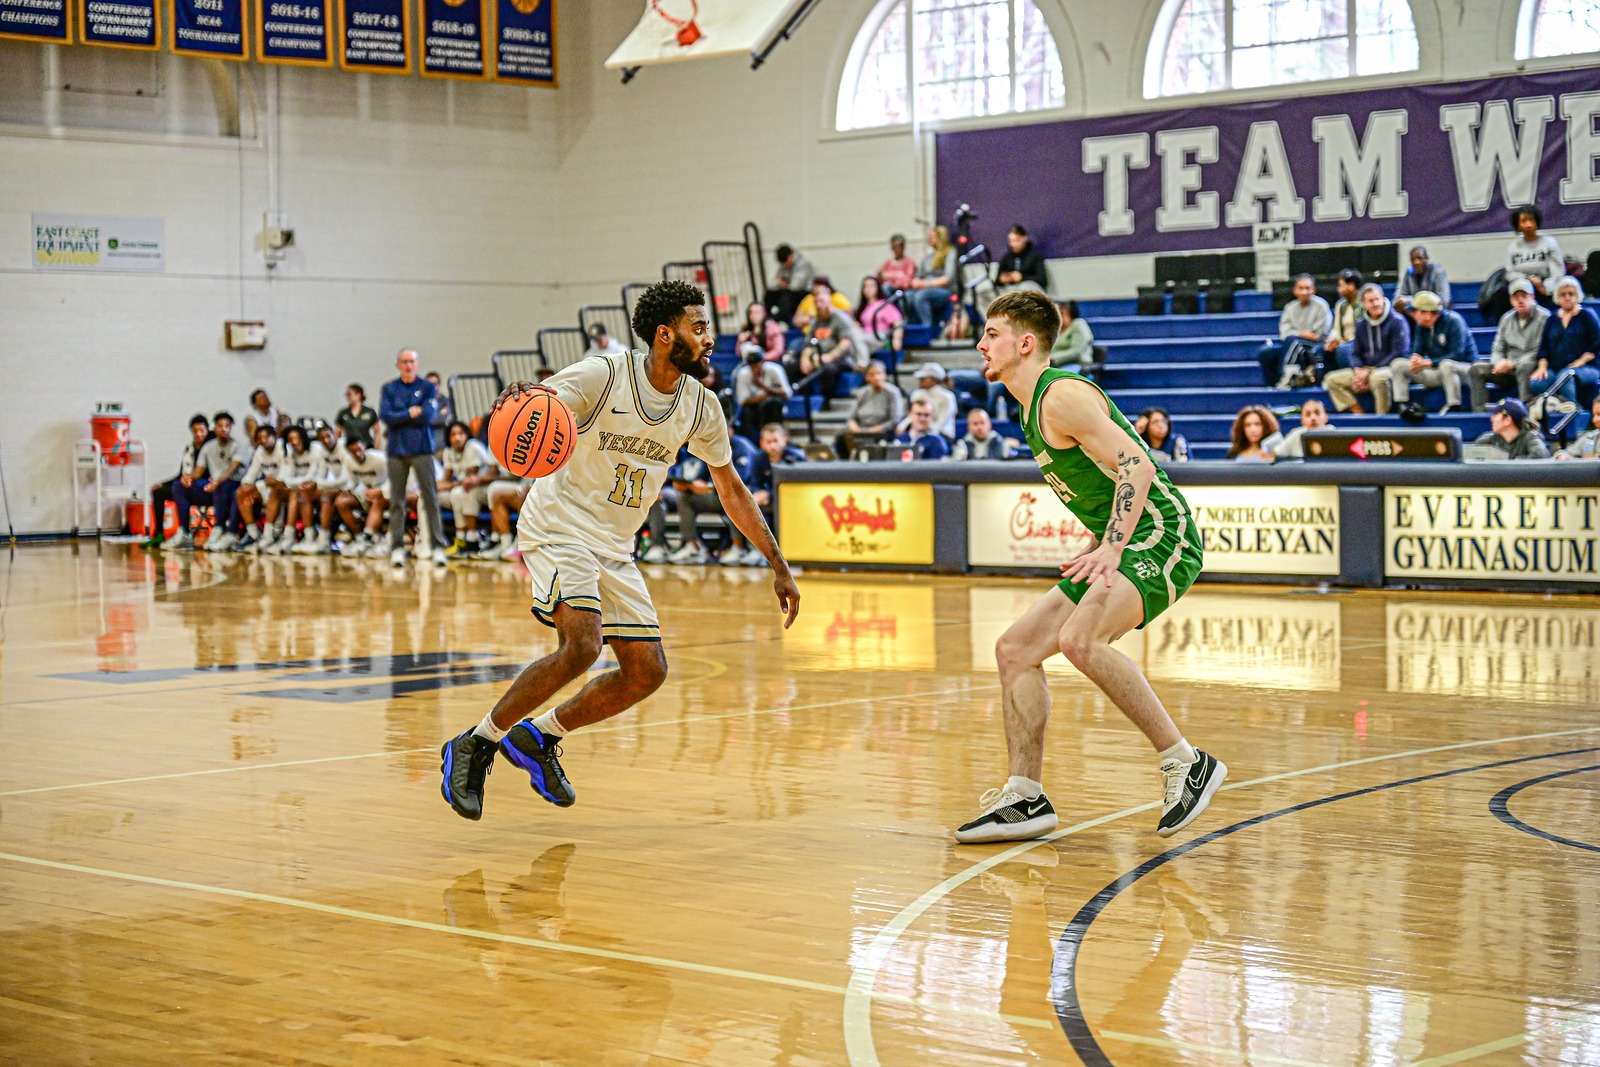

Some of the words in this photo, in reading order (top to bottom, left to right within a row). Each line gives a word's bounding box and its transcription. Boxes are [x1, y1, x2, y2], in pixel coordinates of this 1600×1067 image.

[88, 1, 152, 17] CONFERENCE
[194, 0, 224, 11] 2011
[270, 3, 320, 20] 2015-16
[0, 10, 60, 27] CHAMPIONS
[87, 12, 153, 28] TOURNAMENT
[196, 14, 223, 28] NCAA
[92, 23, 149, 38] CHAMPIONS
[177, 27, 241, 44] TOURNAMENT
[264, 21, 324, 36] CONFERENCE
[347, 28, 403, 42] CONFERENCE
[268, 36, 322, 51] CHAMPIONS
[350, 39, 401, 52] CHAMPIONS
[426, 36, 480, 51] CONFERENCE
[368, 50, 405, 63] DIVISION
[430, 46, 478, 60] CHAMPIONS
[1081, 108, 1409, 237] TEAM
[36, 225, 62, 239] EAST
[36, 240, 99, 256] EQUIPMENT
[511, 410, 542, 465] Wilson
[607, 463, 647, 508] 11
[1206, 506, 1255, 524] NORTH
[1259, 506, 1336, 525] CAROLINA
[1393, 494, 1598, 530] EVERETT
[1195, 513, 1337, 555] ESLEYAN
[1393, 535, 1596, 574] GYMNASIUM
